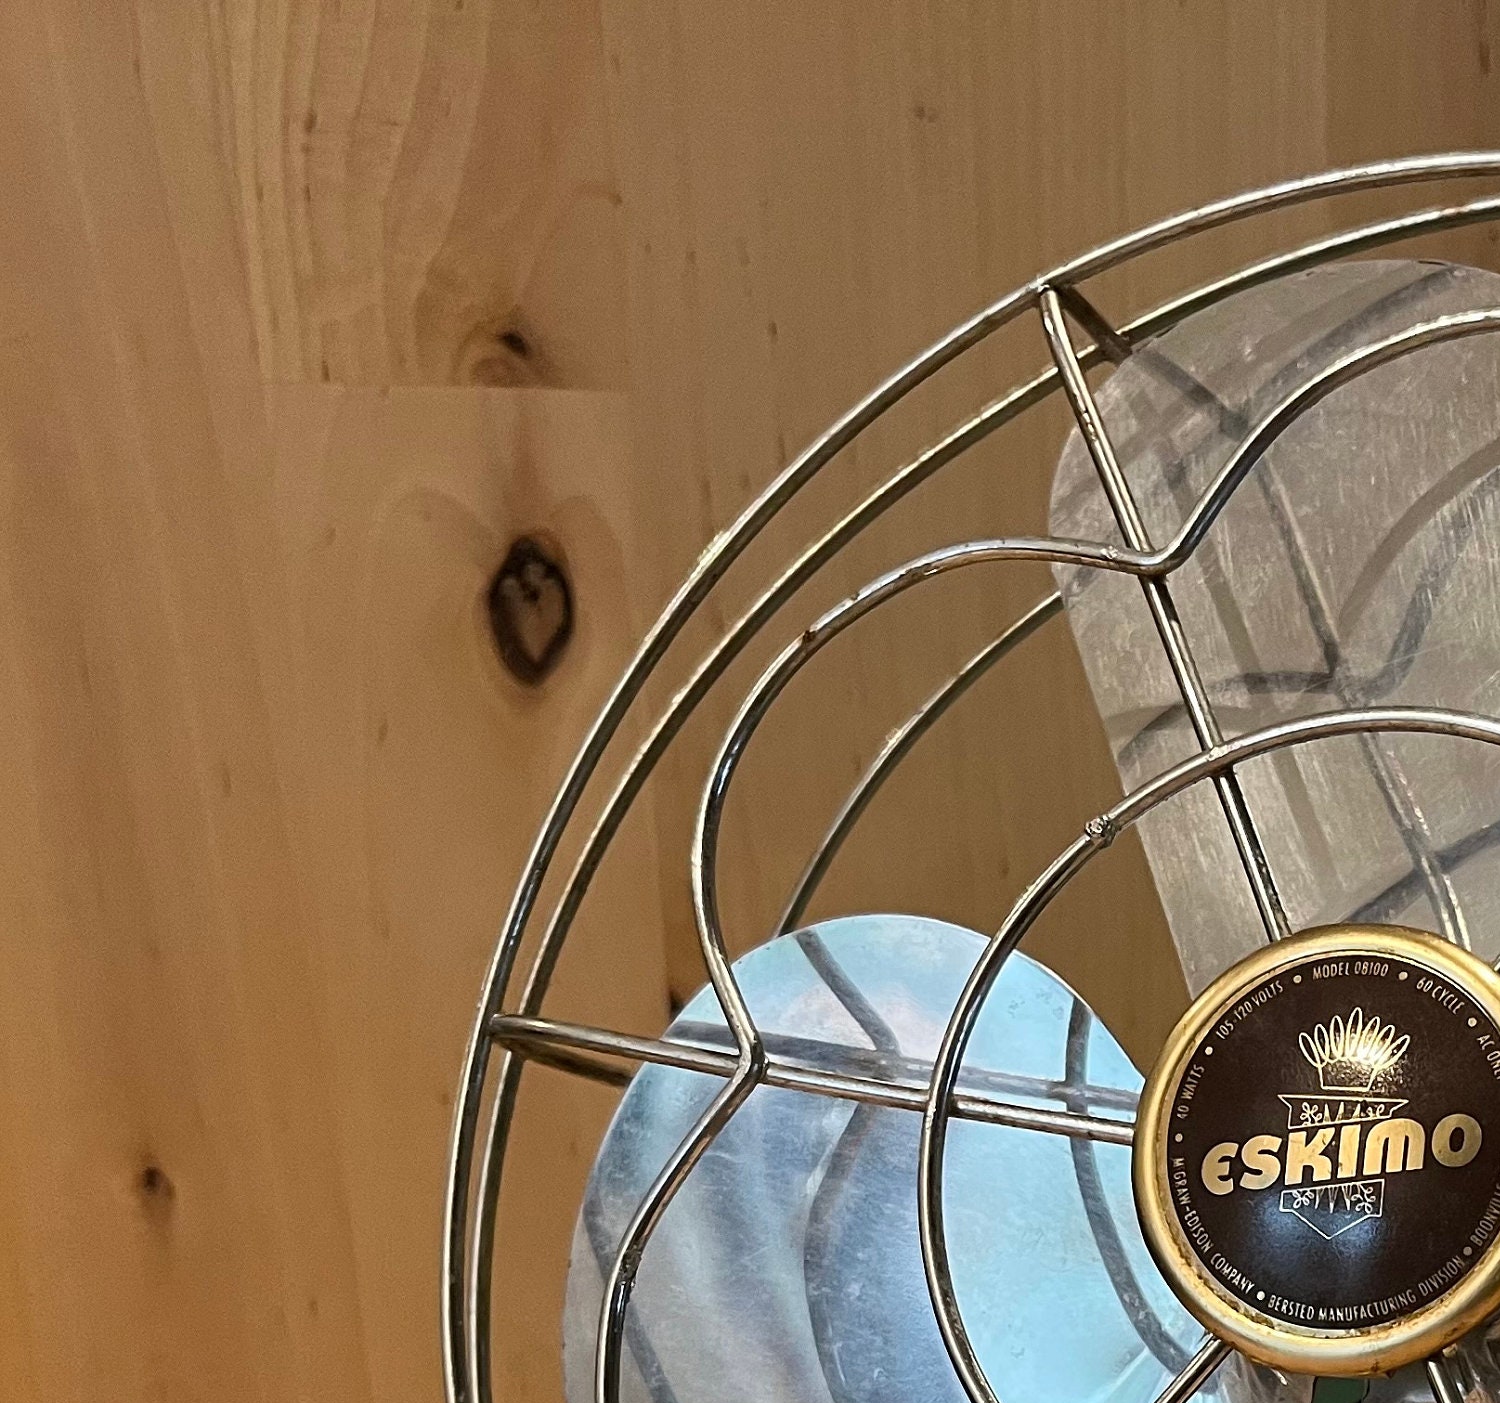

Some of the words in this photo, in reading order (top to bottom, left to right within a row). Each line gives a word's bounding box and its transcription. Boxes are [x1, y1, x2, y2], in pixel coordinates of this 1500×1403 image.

[1313, 964, 1350, 980] MODEL
[1252, 980, 1284, 1007] VOLTS
[1416, 977, 1434, 993] 60
[1431, 985, 1465, 1015] CYCLE
[1477, 1034, 1495, 1050] AC
[1180, 1064, 1205, 1100] WATTS
[1201, 1113, 1483, 1195] ESKIMO
[1210, 1253, 1255, 1294] COMPANY
[1267, 1295, 1315, 1321] BERSTED
[1318, 1289, 1417, 1322] MANUFACTURING
[1418, 1255, 1466, 1297] DIVISION
